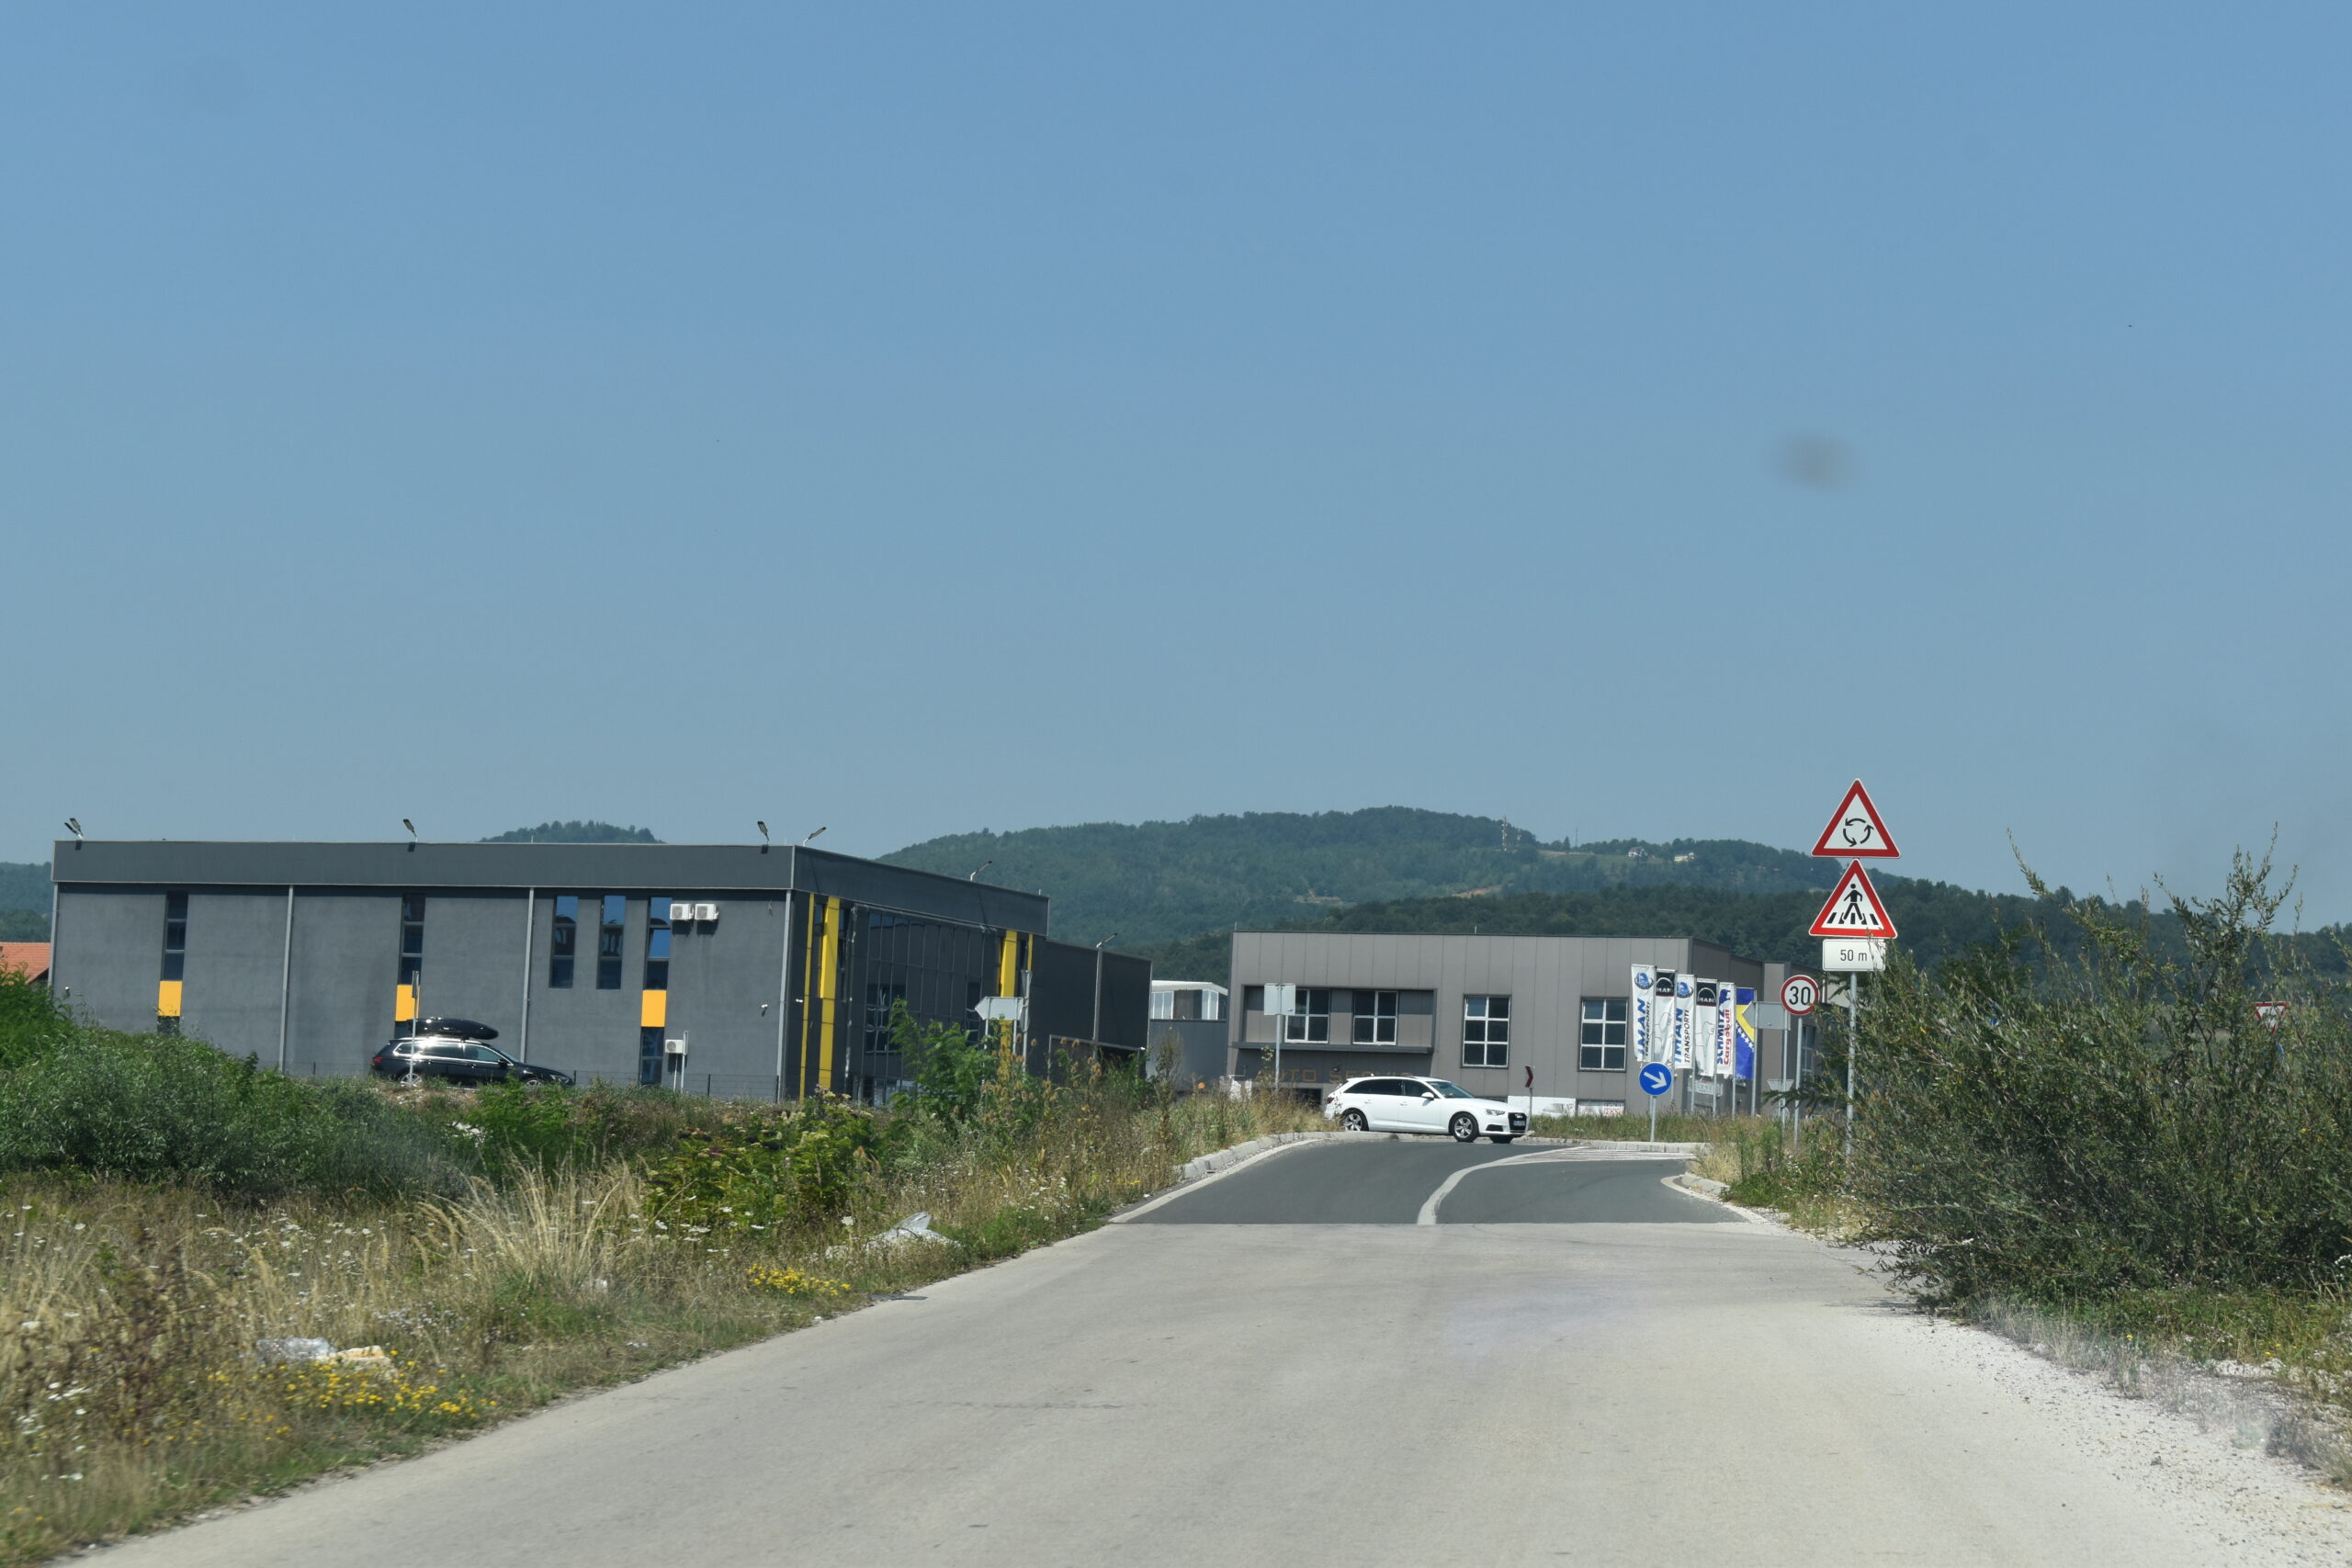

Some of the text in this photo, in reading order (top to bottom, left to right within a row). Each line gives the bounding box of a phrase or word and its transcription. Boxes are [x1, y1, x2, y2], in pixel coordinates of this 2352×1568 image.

[1840, 949, 1867, 962] 50 m
[1789, 986, 1811, 1005] 30
[1675, 1008, 1683, 1063] IMAN
